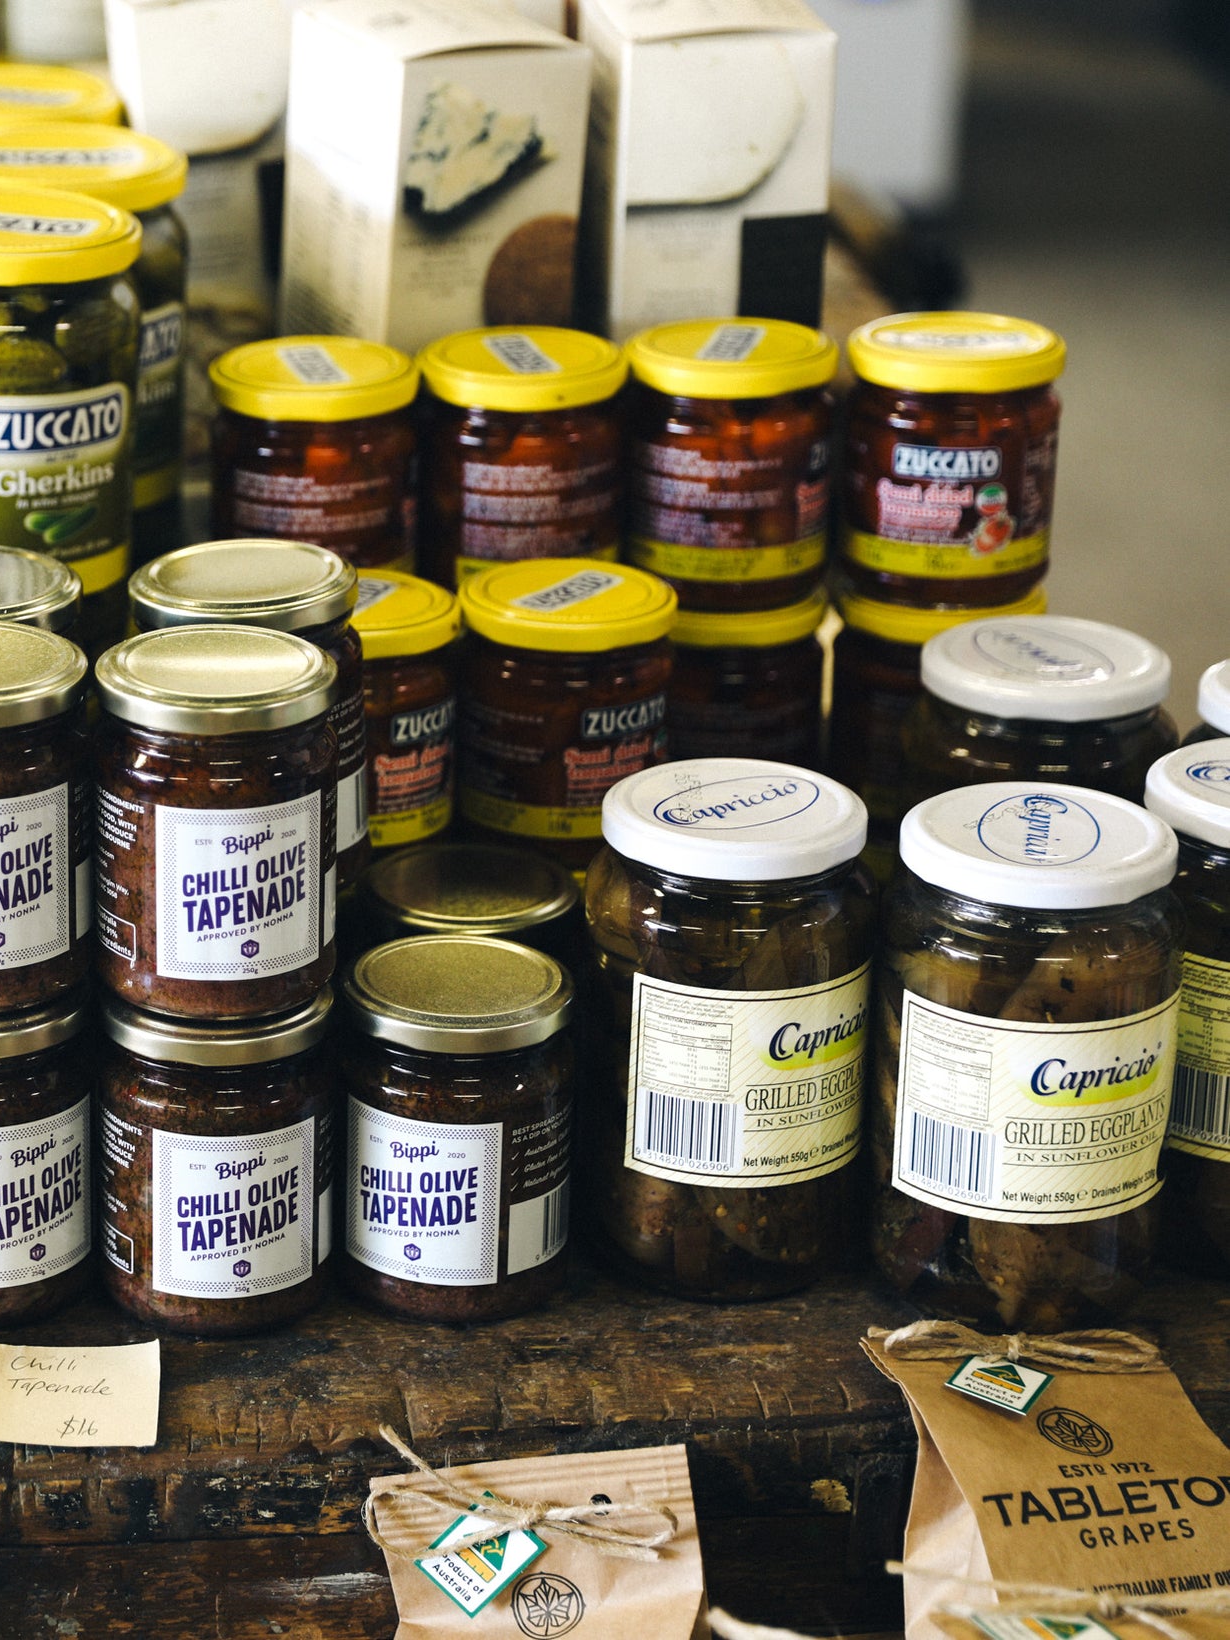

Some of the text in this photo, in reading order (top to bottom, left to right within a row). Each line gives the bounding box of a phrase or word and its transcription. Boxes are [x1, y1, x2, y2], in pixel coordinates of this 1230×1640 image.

[896, 447, 999, 477] ZUCCATO
[662, 779, 799, 824] Capriccio
[26, 822, 42, 831] 2020
[222, 825, 297, 855] Bippi 2020
[1, 834, 52, 875] OLIVE
[182, 841, 306, 896] CHILLI OLIVE
[9, 903, 41, 920] NONNA
[183, 868, 306, 932] TAPENADE
[197, 912, 294, 943] APPROVED BY NONNA
[1030, 1048, 1159, 1098] Capriccio
[746, 1081, 817, 1111] GRILLED
[512, 1116, 555, 1136] BEST SPREAD
[757, 1118, 774, 1127] IN
[1004, 1121, 1085, 1146] GRILLED
[11, 1134, 74, 1168] Bippi 2020
[390, 1141, 440, 1163] Bippi
[743, 1157, 758, 1167] Net
[760, 1155, 789, 1167] Weight
[791, 1153, 809, 1163] 550g
[1017, 1153, 1038, 1162] IN
[1041, 1139, 1138, 1163] SUNFLOWER
[1141, 1130, 1158, 1147] OIL
[42, 1143, 82, 1190] OLIVE
[215, 1152, 289, 1180] Bippi 2020
[361, 1165, 478, 1194] CHILLI OLIVE
[688, 1160, 730, 1172] 026906
[177, 1166, 298, 1218] CHILLI OLIVE
[1002, 1191, 1018, 1203] Net
[1020, 1191, 1052, 1205] Weight
[1054, 1190, 1075, 1204] 550g
[1092, 1183, 1121, 1199] Drained
[178, 1191, 298, 1252] TAPENADE
[360, 1190, 477, 1227] TAPENADE
[38, 1229, 47, 1238] BY
[49, 1212, 74, 1232] NONNA
[369, 1227, 410, 1238] APPROVED
[413, 1230, 422, 1238] BY
[190, 1233, 286, 1262] APPROVED BY NONNA
[405, 1269, 421, 1278] 250g
[10, 1355, 87, 1372] Chilli
[8, 1378, 114, 1396] Tapenade
[965, 1377, 1007, 1395] Product
[965, 1383, 1014, 1404] Australia
[57, 1415, 100, 1438] $16
[1111, 1462, 1155, 1474] 1972
[983, 1475, 1230, 1528] TABLETO
[1080, 1519, 1195, 1550] GRAPES
[432, 1564, 472, 1602] Australia
[1169, 1574, 1212, 1593] FAMILY
